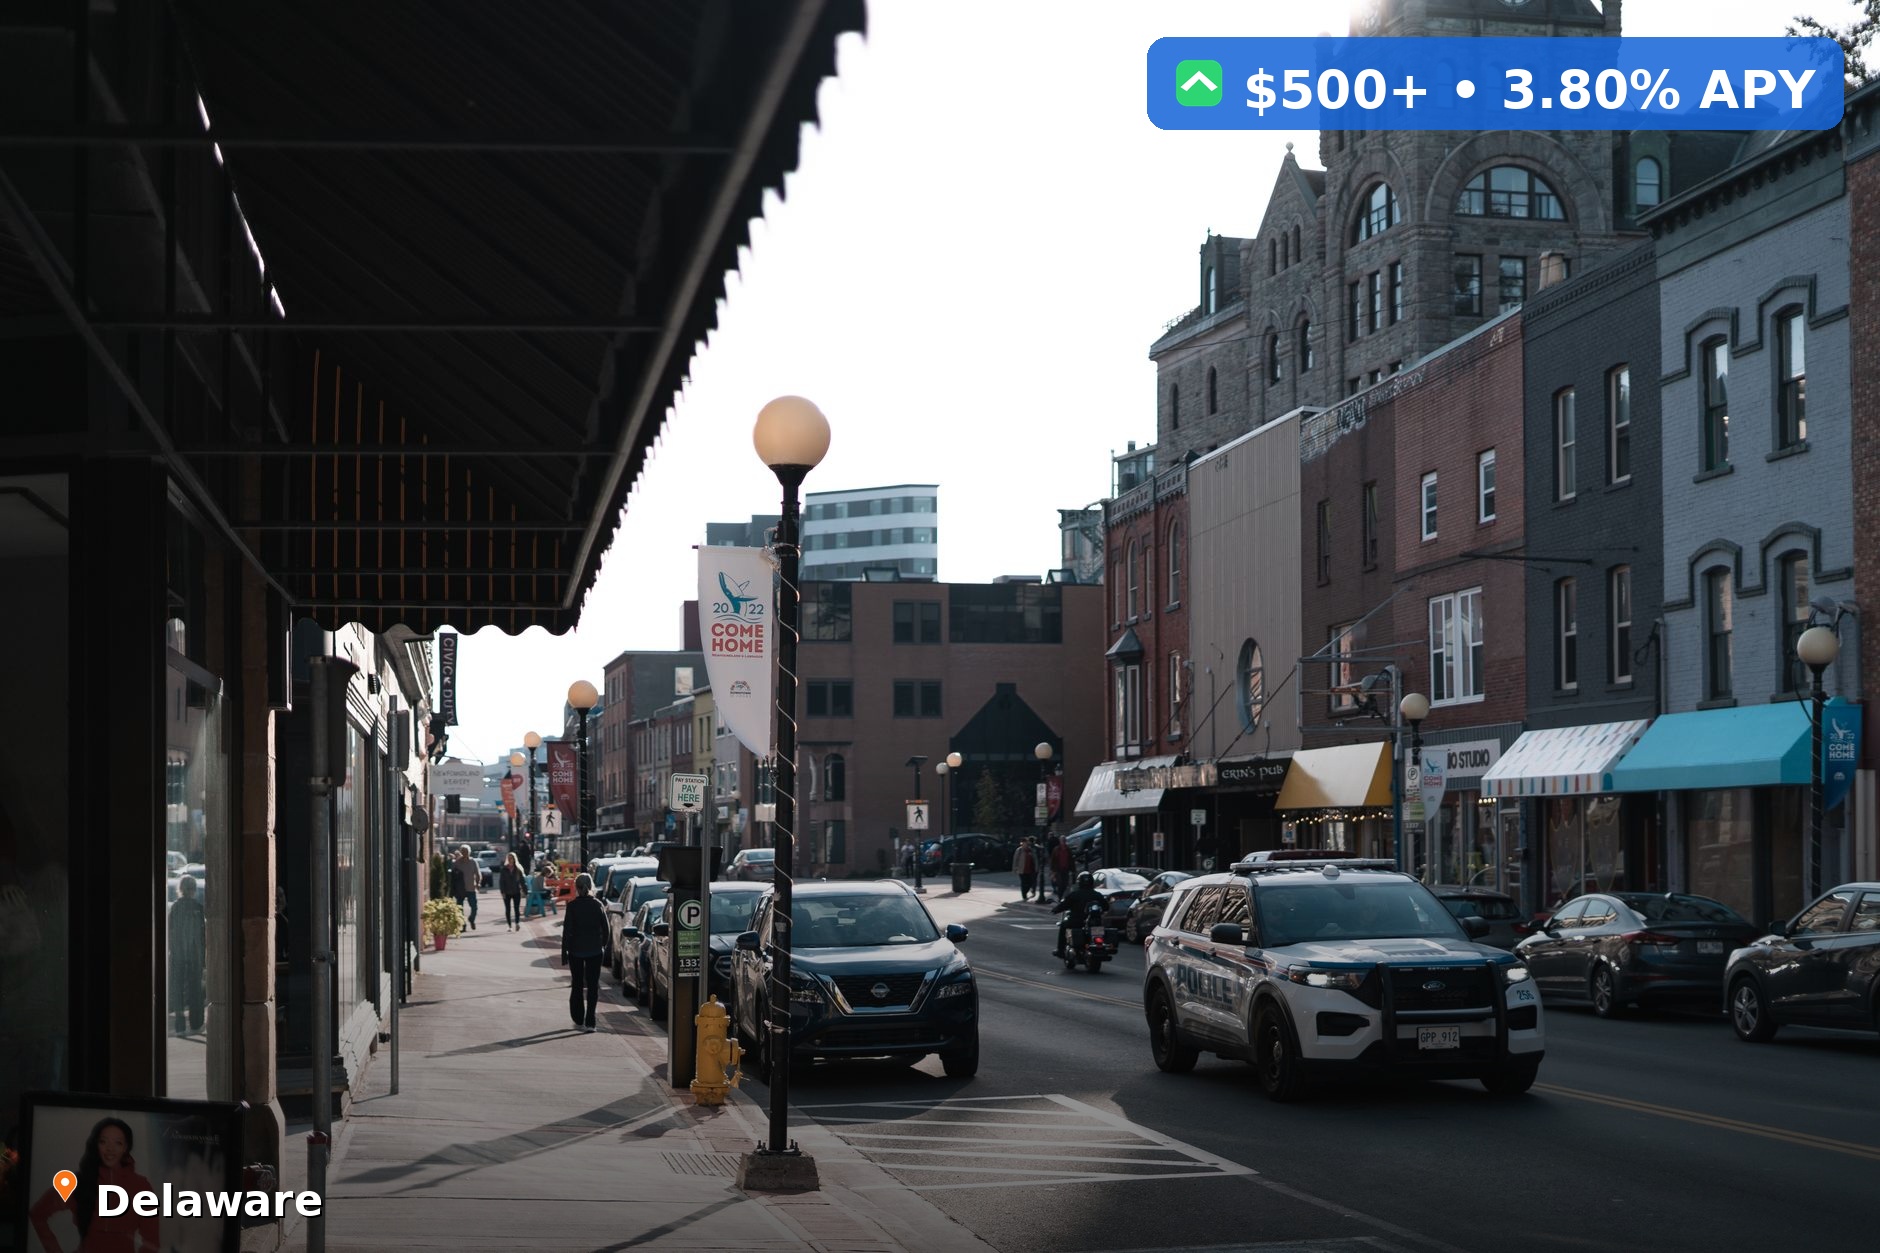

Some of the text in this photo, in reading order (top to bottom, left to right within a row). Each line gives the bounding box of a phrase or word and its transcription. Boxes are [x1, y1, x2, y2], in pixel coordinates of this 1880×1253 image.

[712, 602, 764, 615] 20 22
[711, 623, 764, 638] COME
[711, 638, 764, 653] HOME
[1828, 743, 1855, 751] COME
[1458, 748, 1490, 769] STUDIO
[1829, 751, 1855, 759] HOME
[681, 784, 698, 793] PAY
[677, 793, 700, 803] HERE
[687, 906, 700, 924] P
[1176, 963, 1234, 1005] POLICE
[1516, 989, 1535, 1000] 256
[1420, 1031, 1458, 1043] GPP 912
